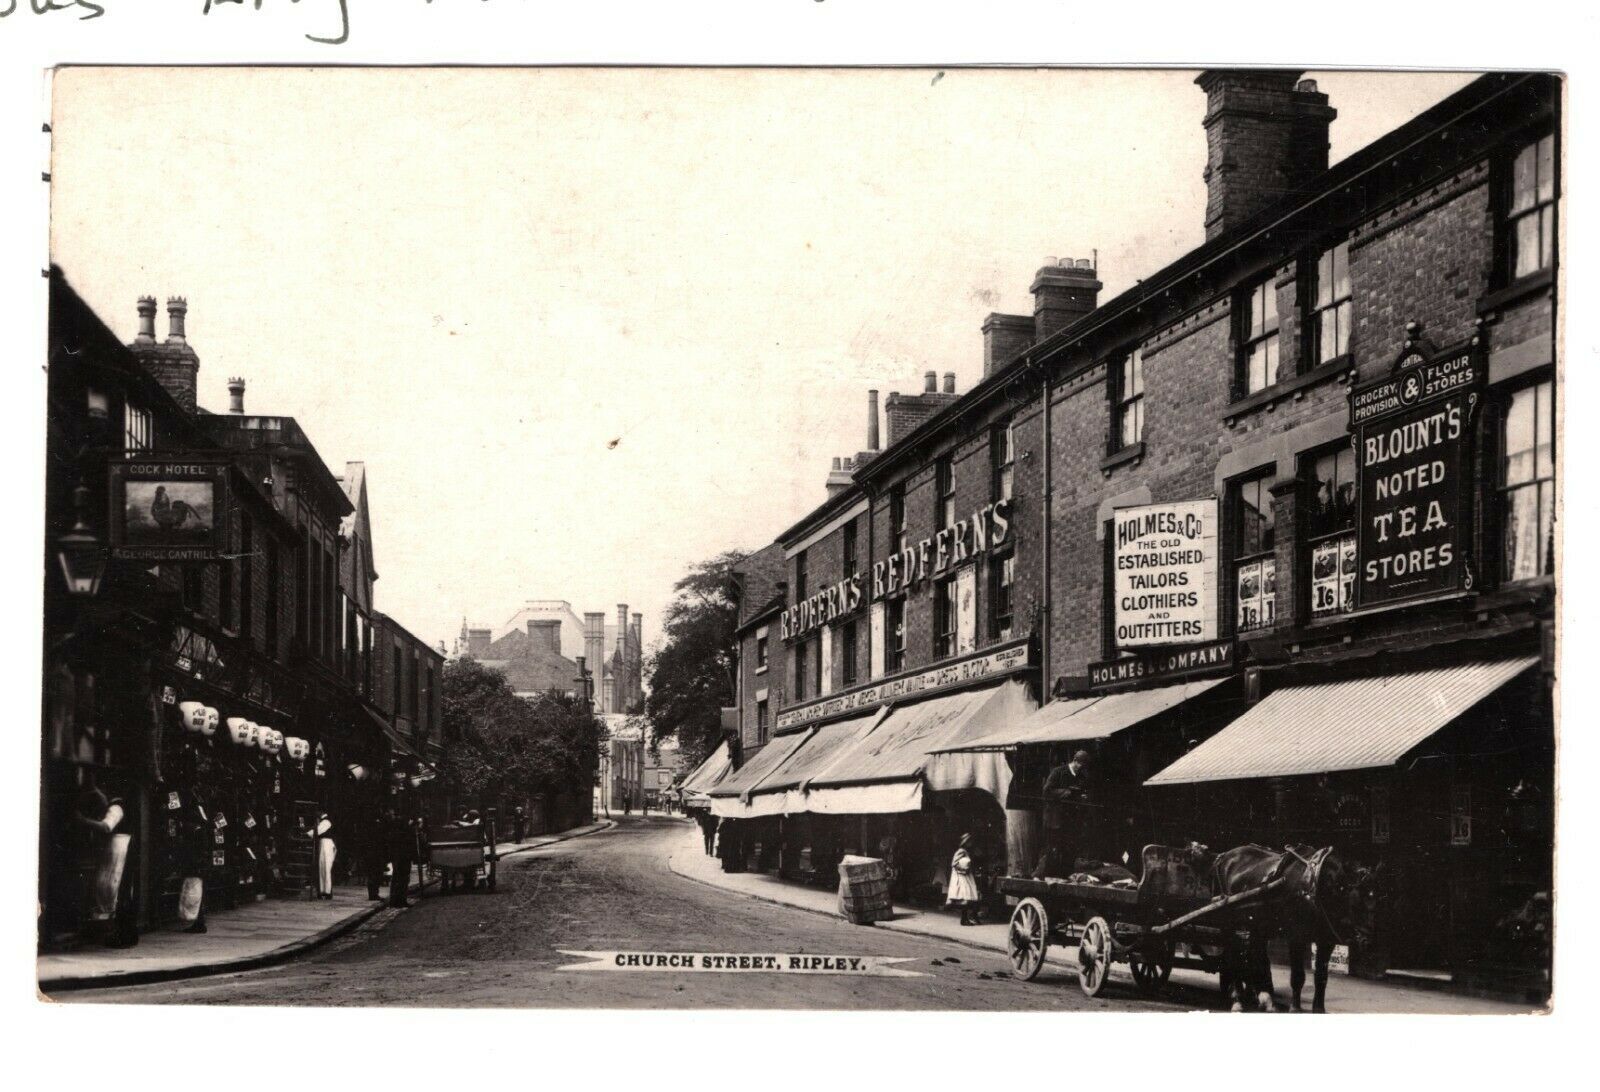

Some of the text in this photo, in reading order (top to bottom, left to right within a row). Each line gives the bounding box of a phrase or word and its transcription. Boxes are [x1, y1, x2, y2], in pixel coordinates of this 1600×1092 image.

[1427, 356, 1469, 379] FLOUR
[1405, 378, 1419, 398] &
[1425, 369, 1473, 394] STORES
[1355, 397, 1399, 420] PROVISION
[1365, 404, 1461, 466] BLOUNT'S
[130, 465, 206, 475] COCK HOTEL
[1376, 460, 1445, 500] NOTED
[1374, 500, 1447, 543] TEA
[1137, 538, 1181, 550] THE OLD
[168, 550, 215, 560] CANTRILL
[1118, 550, 1203, 570] ESTABLISHED
[1366, 543, 1453, 582] STORES
[1128, 571, 1189, 590] TAILORS
[1121, 591, 1198, 611] CLOTHIERS
[1148, 611, 1170, 620] AND
[1118, 620, 1202, 640] OUTFITTERS
[1092, 661, 1144, 684] HOLMES
[1159, 646, 1229, 673] COMPANY
